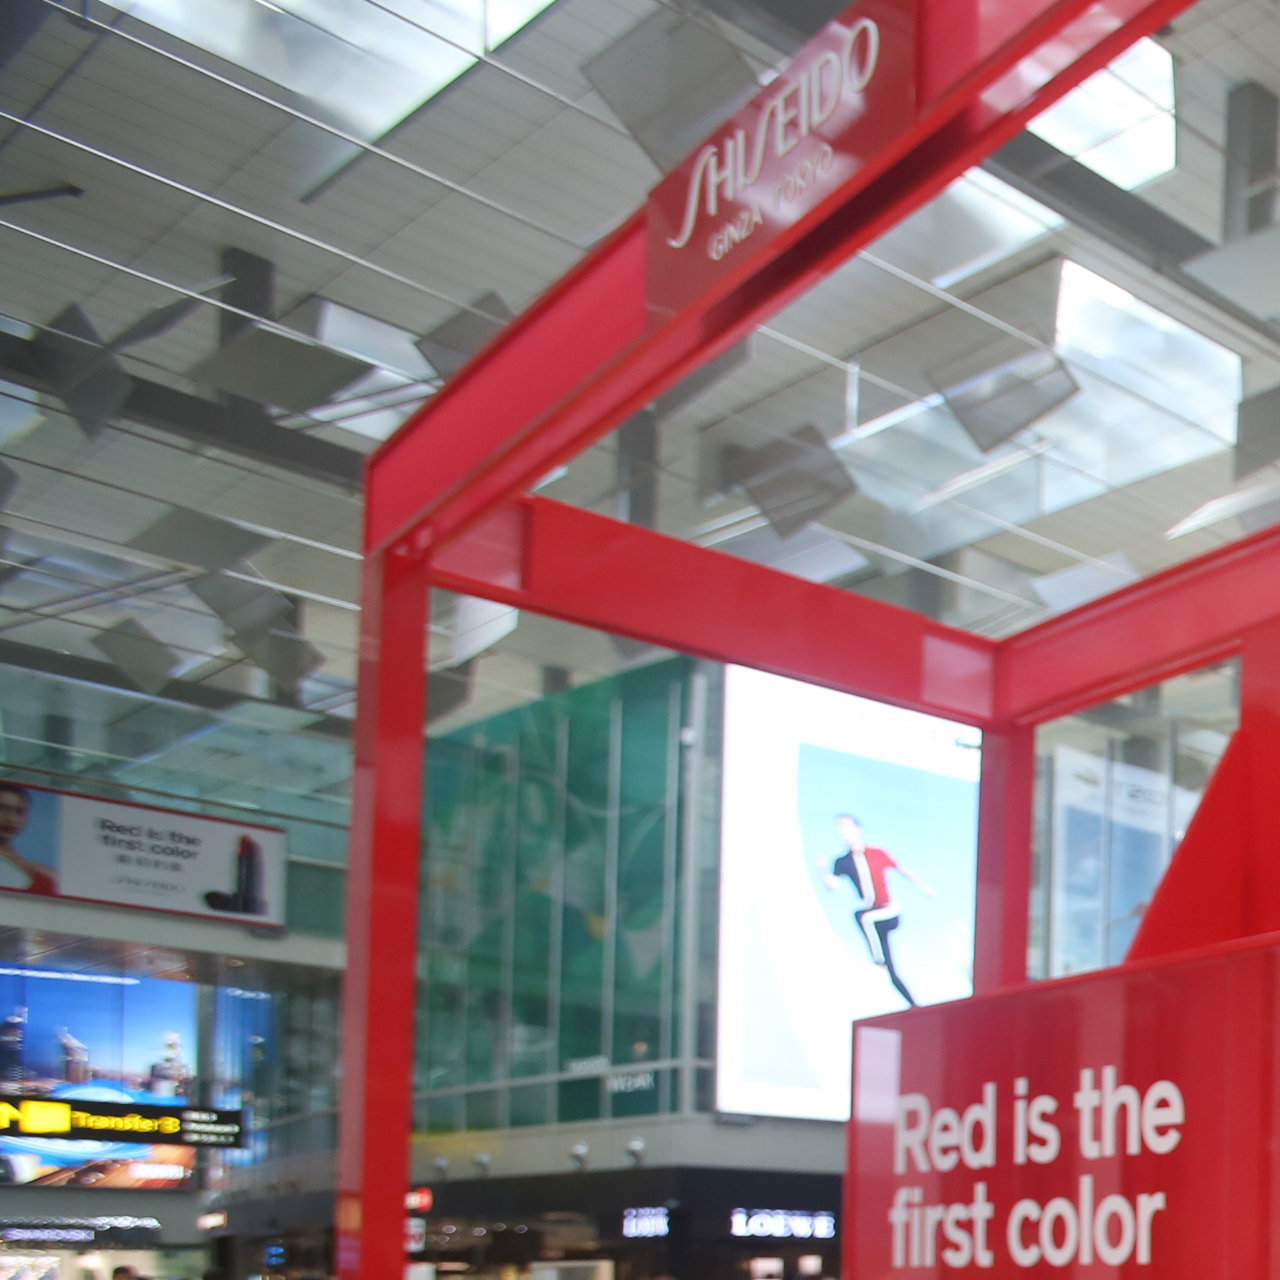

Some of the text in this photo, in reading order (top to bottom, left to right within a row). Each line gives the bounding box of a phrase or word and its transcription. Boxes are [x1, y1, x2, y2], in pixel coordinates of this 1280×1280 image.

[667, 17, 880, 249] SHISEIDO
[707, 145, 834, 261] GINZA TOKYO
[100, 817, 143, 837] Red
[169, 829, 202, 848] the
[150, 840, 200, 861] color
[73, 1111, 159, 1133] Transfer
[893, 1064, 1186, 1176] Red is the
[731, 1209, 836, 1239] LOEWE
[889, 1173, 1167, 1269] first color
